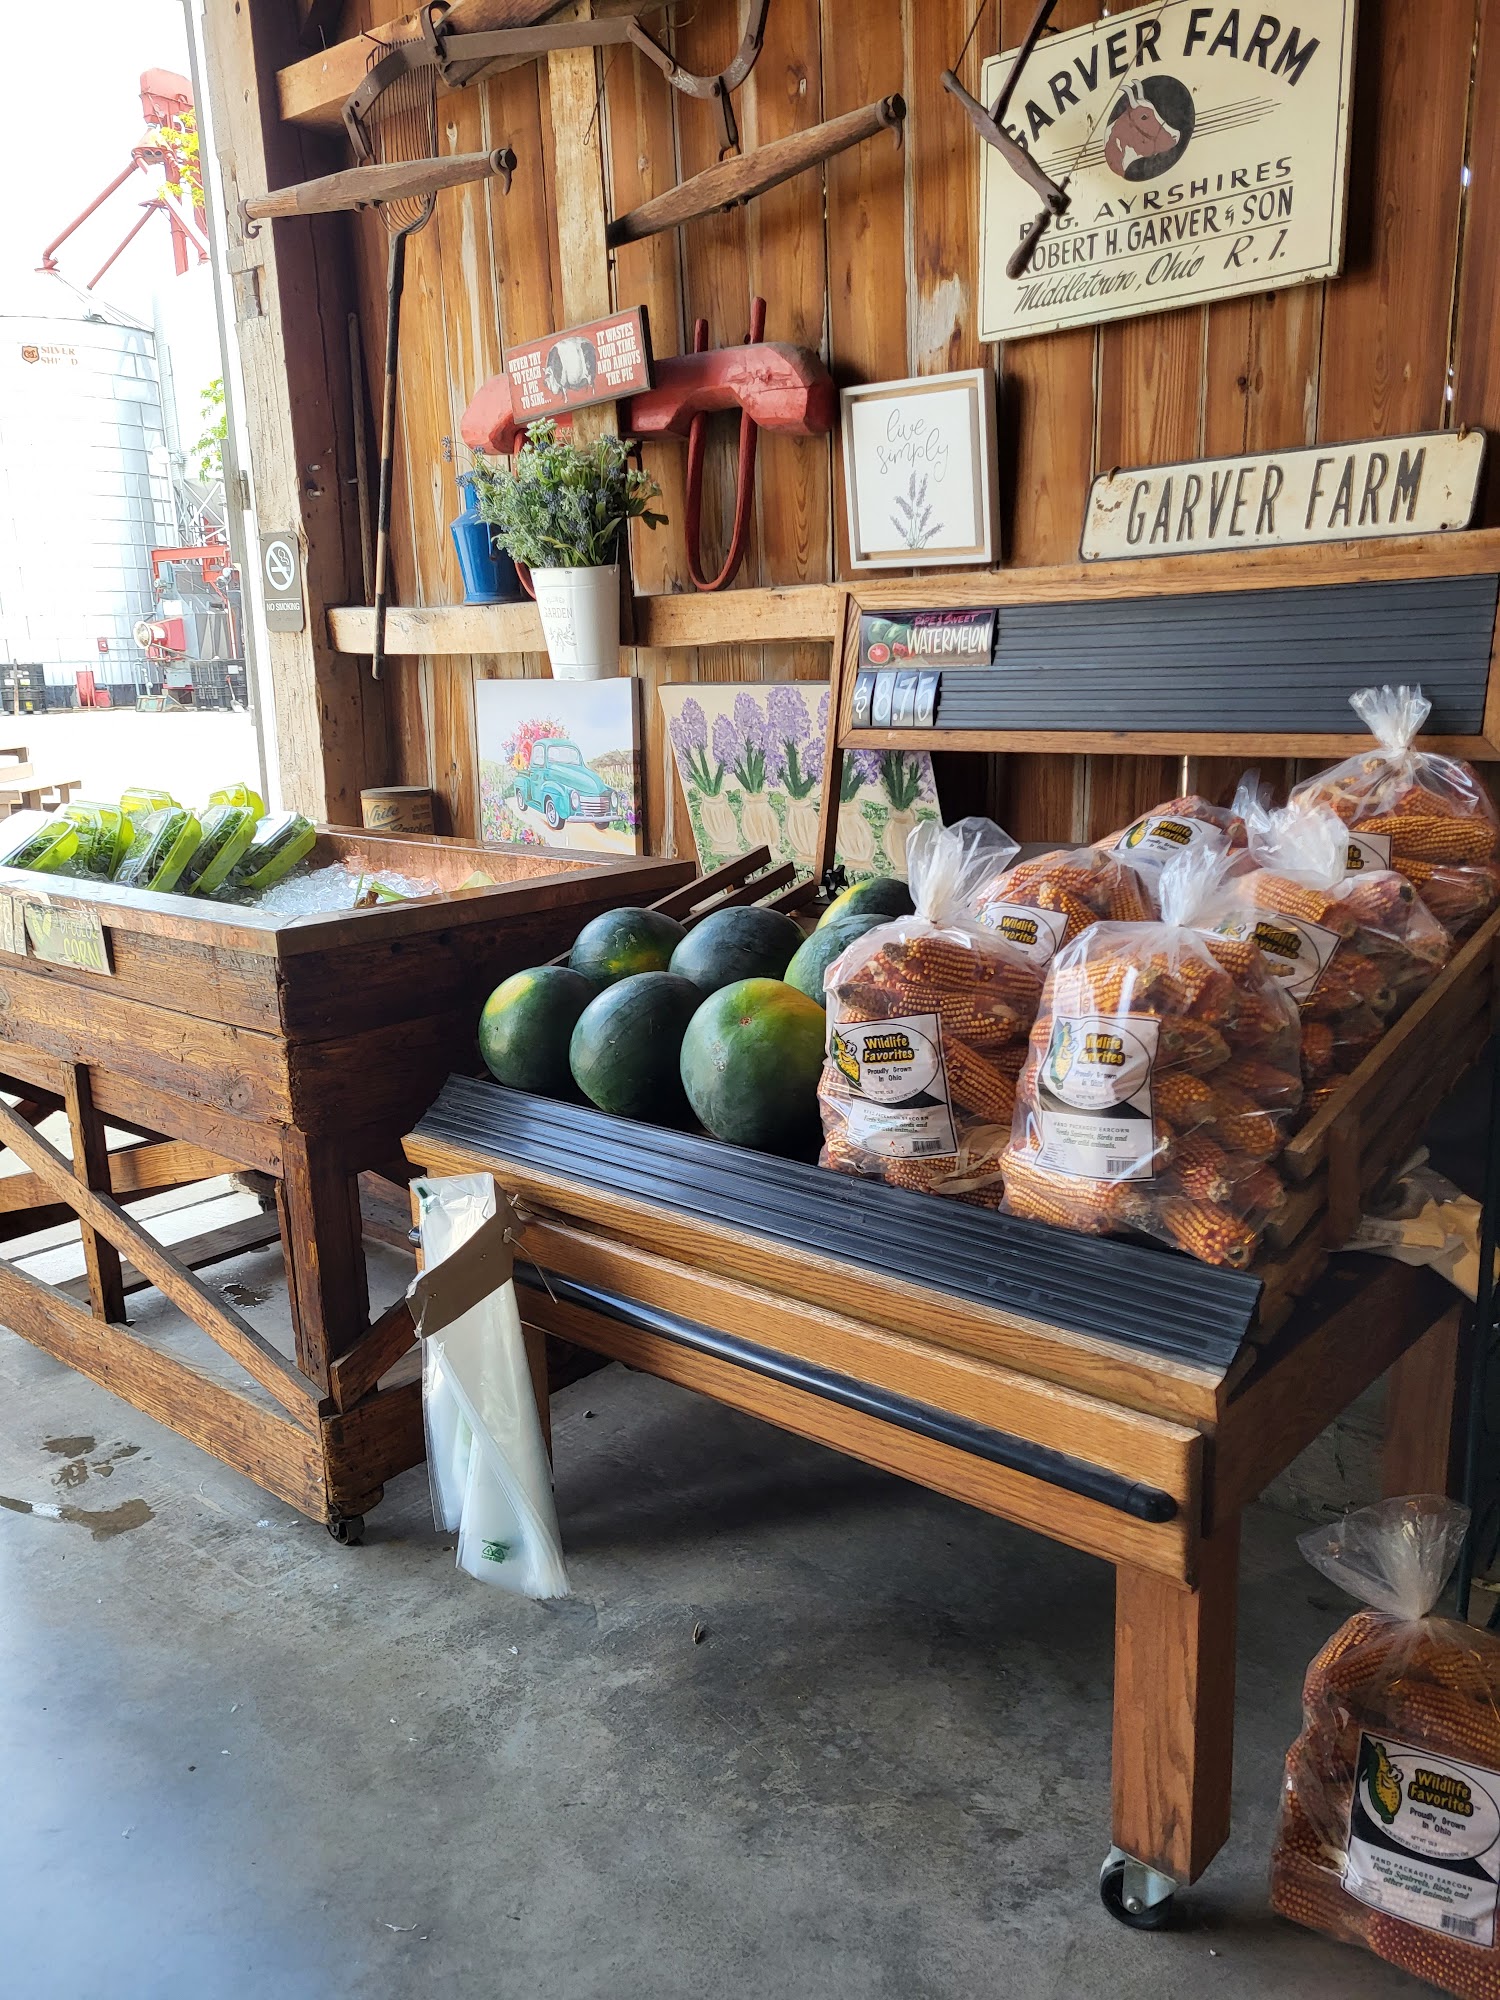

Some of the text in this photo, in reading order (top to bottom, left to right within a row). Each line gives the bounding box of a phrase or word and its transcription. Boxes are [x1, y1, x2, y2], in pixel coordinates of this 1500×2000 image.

[1005, 8, 1320, 152] GARVER FARM
[1020, 156, 1292, 240] RG. AYRSHIRES
[1025, 233, 1099, 275] OBERT
[1128, 205, 1222, 252] GARVER
[1241, 186, 1293, 226] SON
[1014, 269, 1142, 314] Middletown,
[1145, 245, 1205, 287] Ohio
[1223, 235, 1259, 270] R.
[596, 322, 634, 346] IT WASTES
[598, 336, 637, 360] YOUR TIME
[41, 356, 78, 366] SHID
[508, 351, 542, 373] NEVER TRY
[597, 350, 641, 375] AND ANNOYS
[512, 366, 542, 386] TO TEACH
[605, 367, 634, 387] THE PIG
[523, 380, 539, 396] A PIG
[521, 396, 531, 410] TO
[887, 409, 927, 442] live
[877, 428, 949, 483] simply
[1126, 447, 1426, 545] GARVER FARM
[266, 602, 300, 611] NO SMOKING
[944, 613, 980, 625] SWEET
[907, 622, 991, 655] WATERMELON
[1151, 828, 1190, 845] Favorites
[1160, 821, 1192, 837] Wildlife
[1002, 917, 1038, 933] Wildlife
[63, 938, 103, 970] CORN
[864, 1034, 909, 1050] Wildlife
[863, 1049, 914, 1062] Favorites
[867, 1067, 889, 1076] Proudly
[1416, 1770, 1470, 1799] Wildlife
[1409, 1784, 1472, 1815] Favorites
[1409, 1806, 1437, 1824] Proudly
[1434, 1824, 1452, 1837] Ohio
[1370, 1854, 1473, 1892] HAND PACKAGED EARCORN
[1372, 1862, 1470, 1900] Feeds Squirrels, Birds and
[1383, 1876, 1403, 1888] other
[1404, 1883, 1422, 1894] wild
